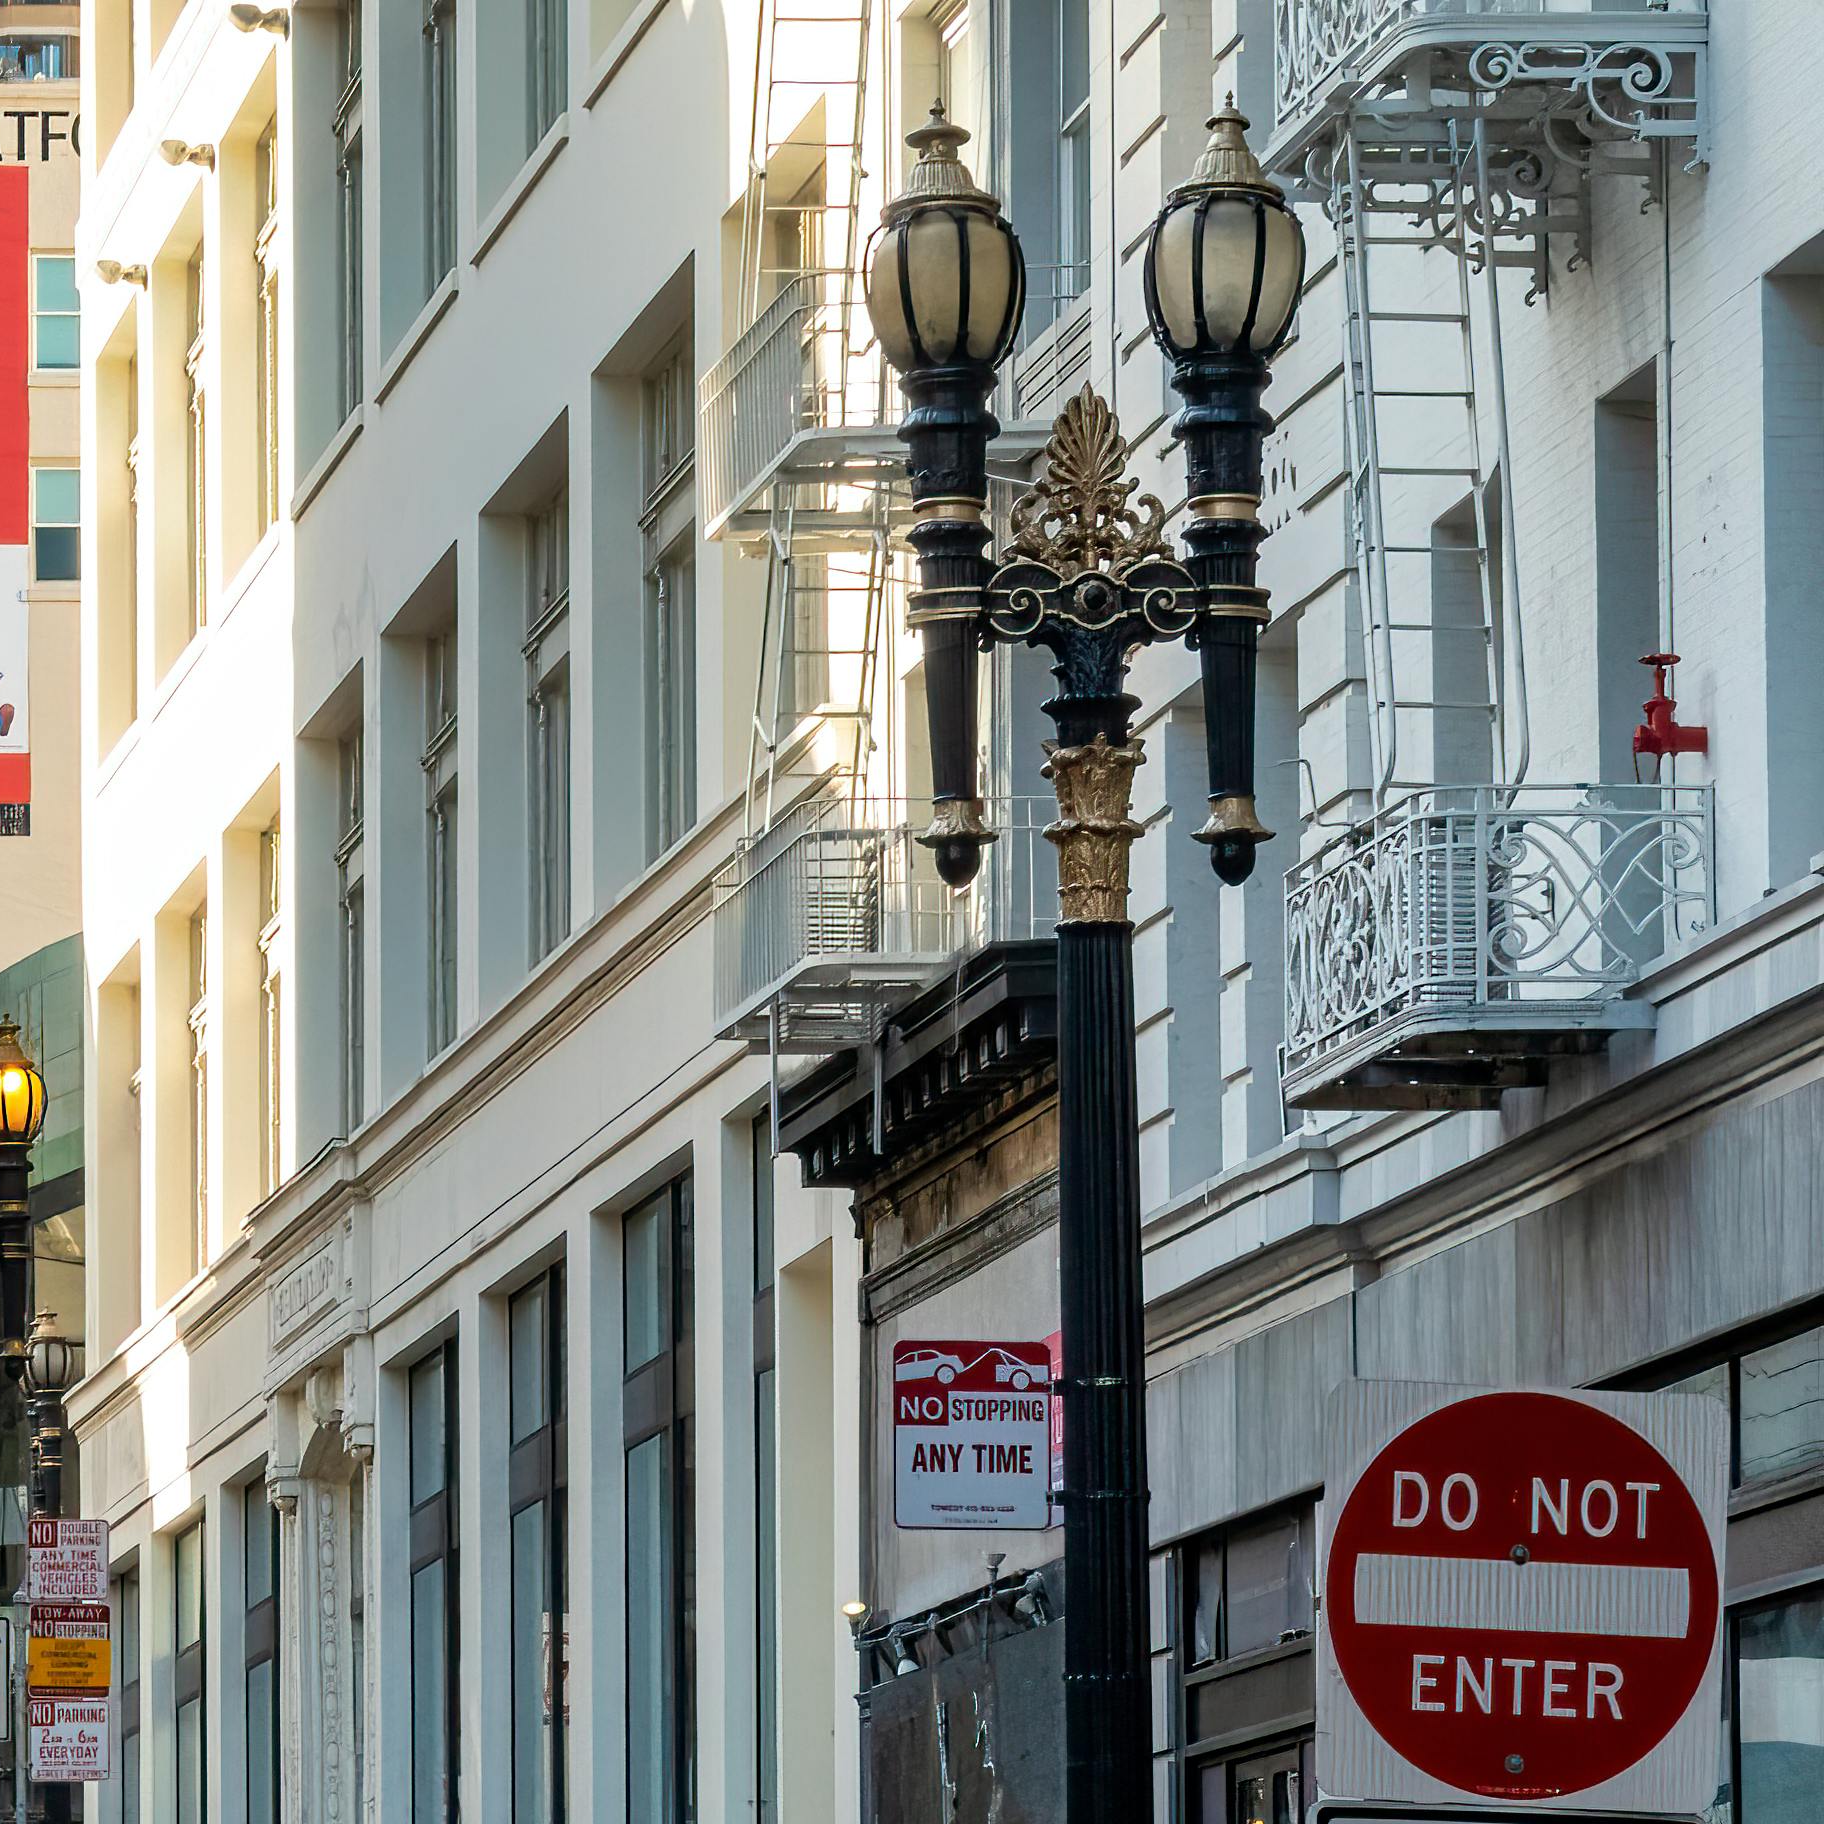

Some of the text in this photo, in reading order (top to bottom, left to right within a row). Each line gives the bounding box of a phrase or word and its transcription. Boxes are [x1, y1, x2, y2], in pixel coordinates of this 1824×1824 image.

[901, 1396, 1044, 1422] NO STOPPING
[911, 1443, 1033, 1474] ANY TIME
[1393, 1470, 1660, 1539] DO NOT
[32, 1522, 101, 1544] NO DOUBLE
[60, 1535, 101, 1546] PARKING
[40, 1550, 97, 1561] ANY TIME
[32, 1561, 104, 1573] COMMERCIAL
[40, 1573, 98, 1583] VEHICLES
[39, 1584, 98, 1595] INCLUDED
[37, 1607, 102, 1619] TOW-AWAY
[33, 1620, 54, 1637] NO
[1411, 1654, 1624, 1720] ENTER
[32, 1702, 106, 1724] NO PARKING
[39, 1746, 99, 1759] EVERYDAY
